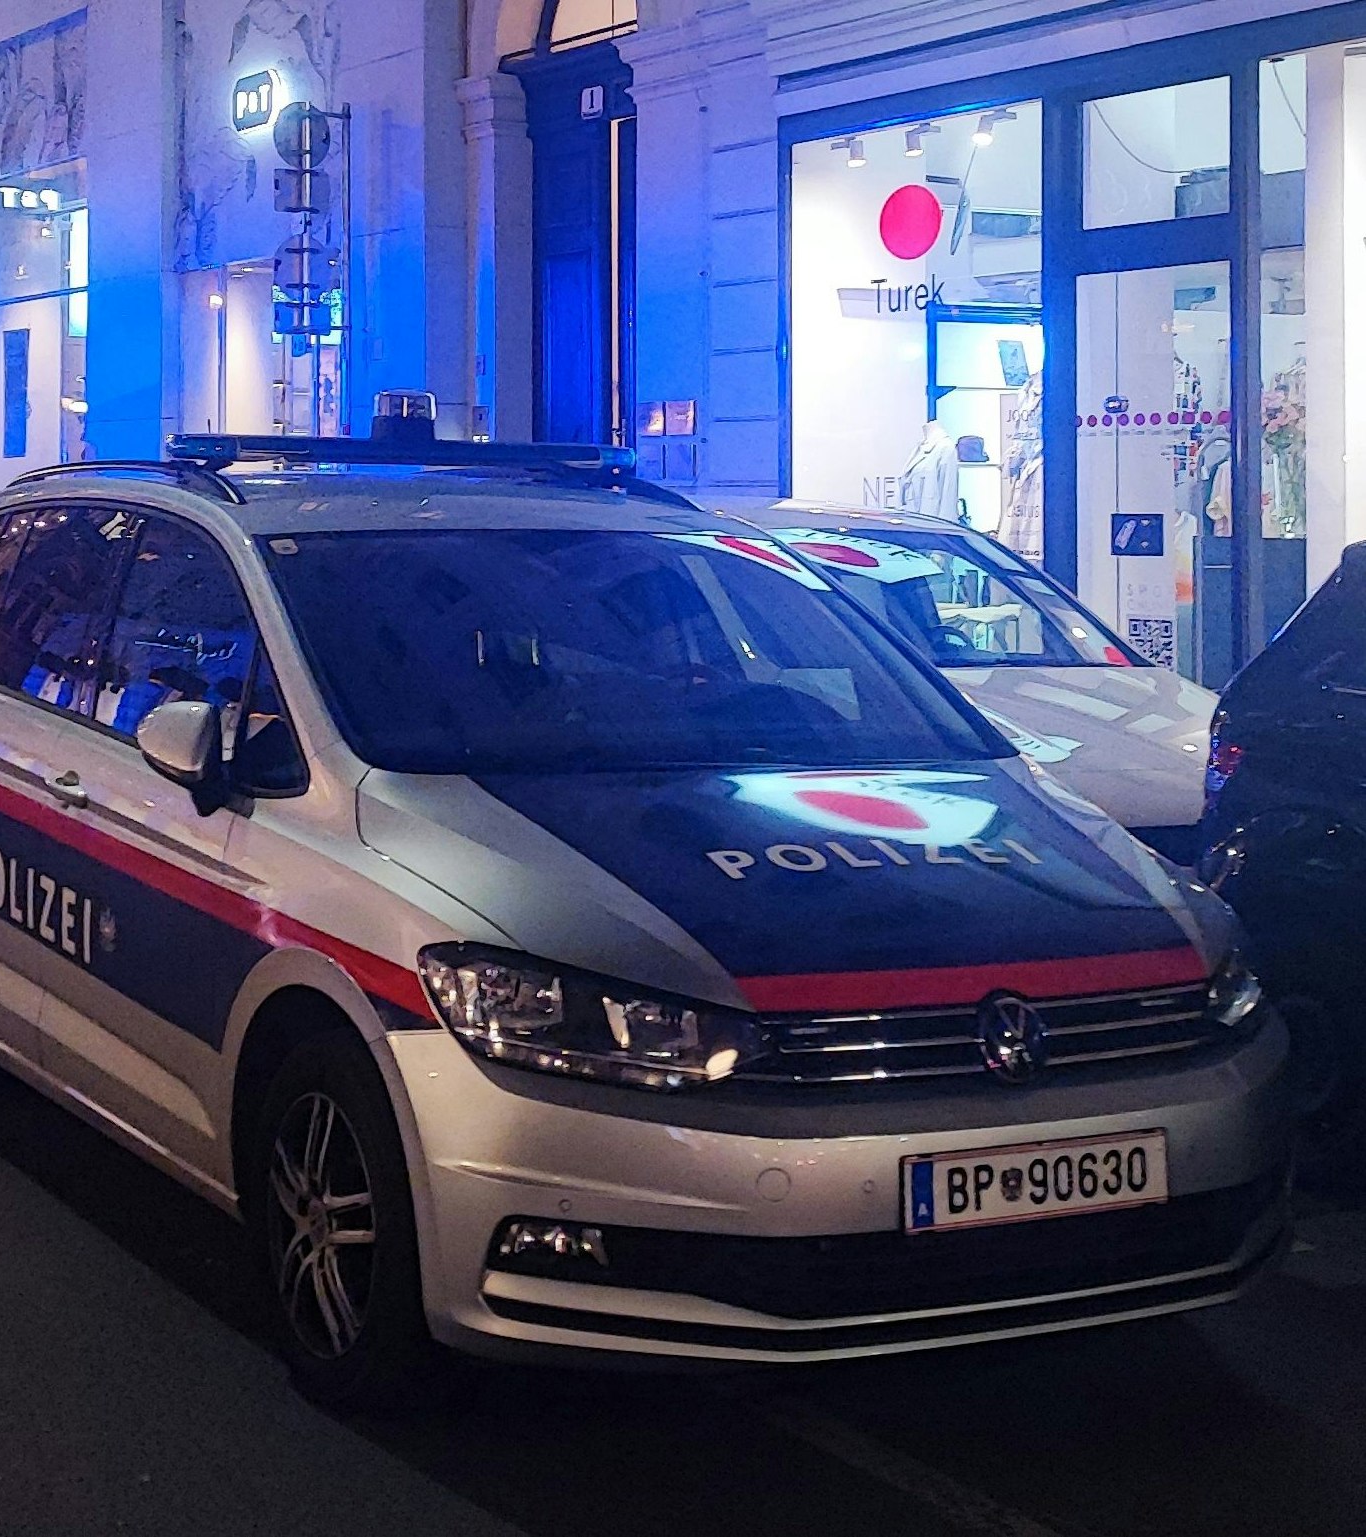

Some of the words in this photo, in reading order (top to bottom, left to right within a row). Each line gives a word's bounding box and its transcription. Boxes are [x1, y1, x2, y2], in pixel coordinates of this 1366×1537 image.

[588, 89, 595, 110] 1
[870, 274, 945, 313] Turek
[947, 1164, 994, 1214] BP
[1028, 1146, 1147, 1205] 90630
